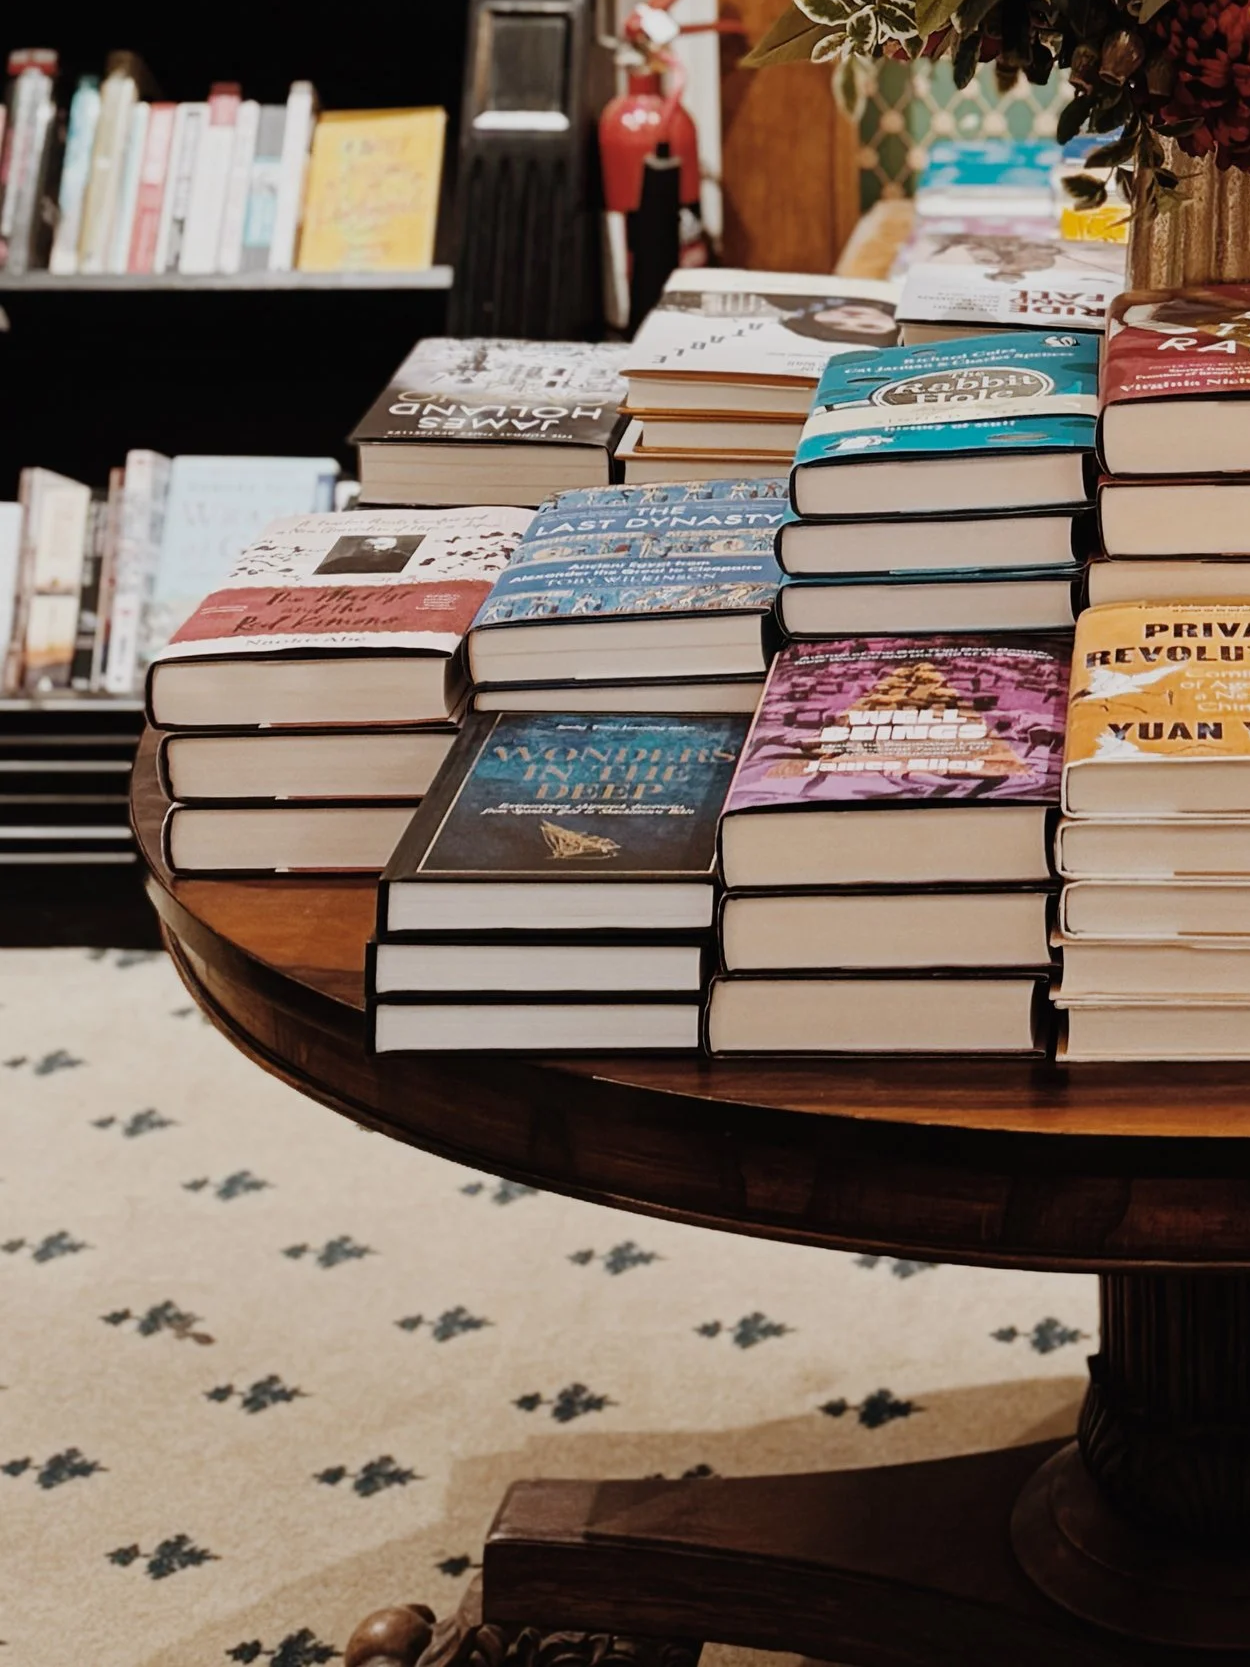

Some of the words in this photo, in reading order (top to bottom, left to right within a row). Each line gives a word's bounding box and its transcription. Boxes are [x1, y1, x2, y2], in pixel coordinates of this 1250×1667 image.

[1010, 289, 1104, 302] FALL
[1009, 305, 1106, 318] RIDE
[893, 373, 1037, 395] Rabbit
[915, 388, 1015, 406] Hole
[389, 402, 602, 421] HOLLAND
[417, 416, 560, 432] JAMES
[634, 505, 687, 516] THE
[535, 518, 616, 537] LAST
[624, 513, 784, 530] DYNASTY
[1180, 680, 1204, 690] of
[1108, 721, 1223, 741] YUAN
[493, 746, 737, 763] WONDERS
[523, 764, 573, 782] IN
[600, 764, 690, 782] THE
[535, 782, 665, 800] DEEP
